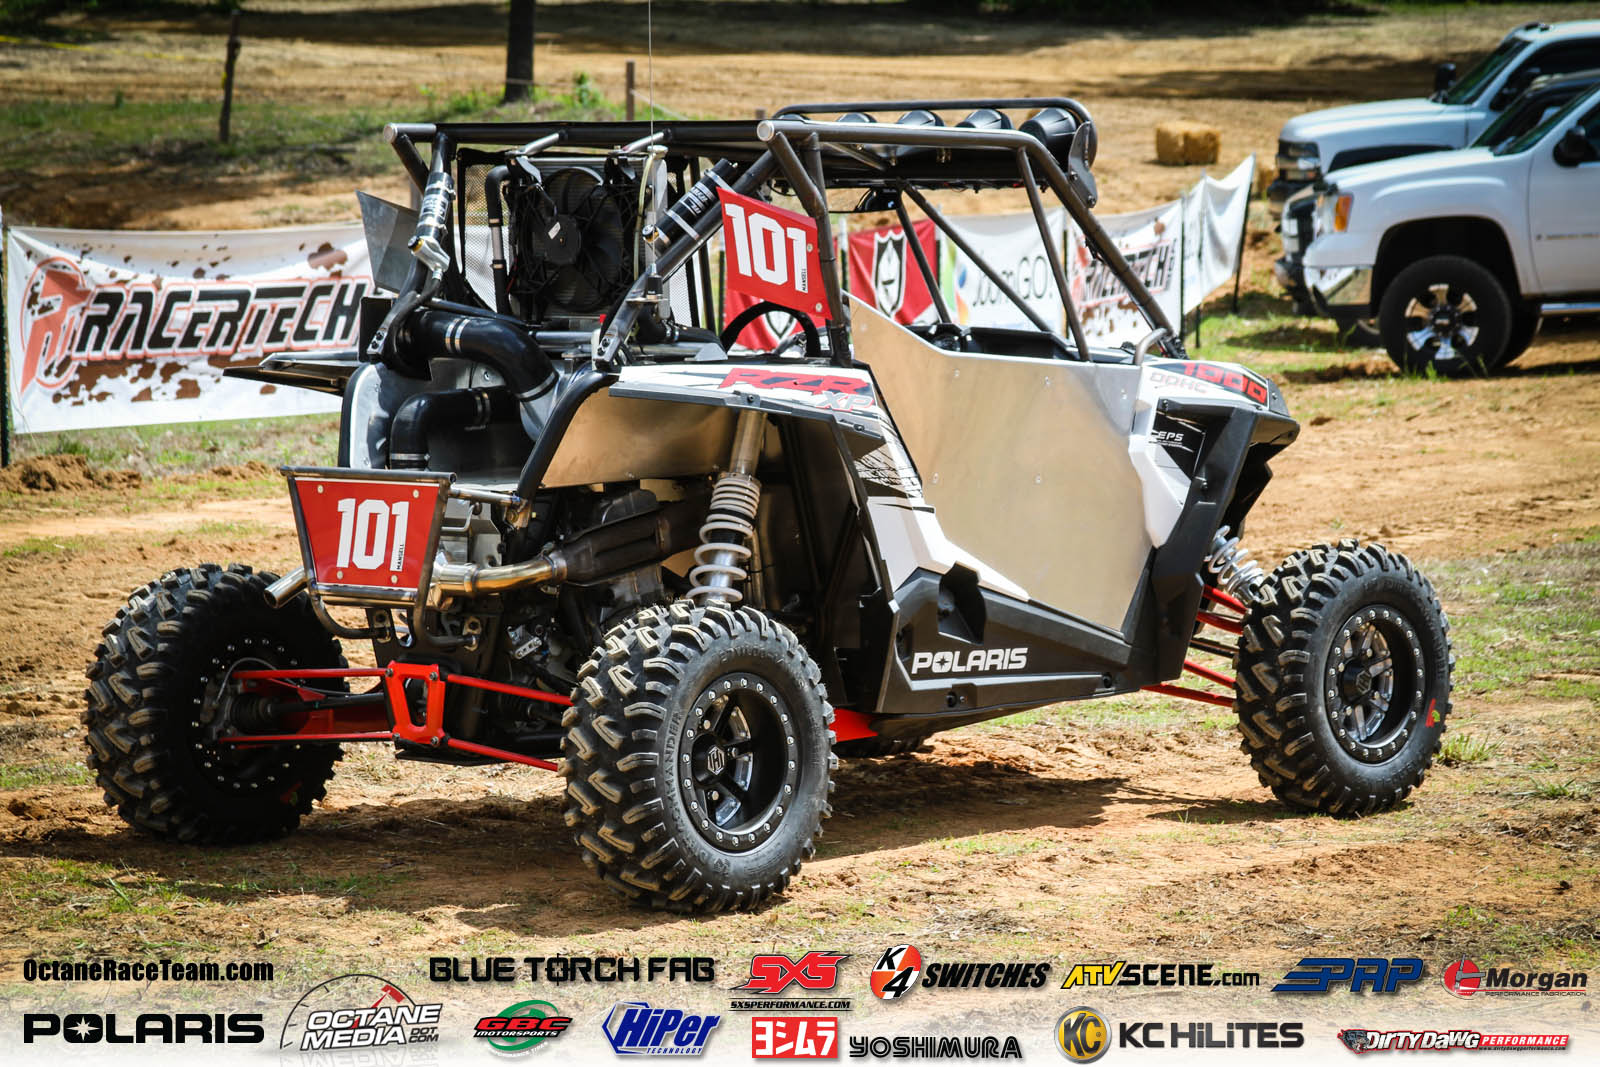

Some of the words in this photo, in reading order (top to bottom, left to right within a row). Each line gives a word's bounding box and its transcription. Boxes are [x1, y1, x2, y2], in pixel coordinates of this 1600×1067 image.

[725, 203, 808, 293] 101
[74, 284, 366, 352] RACERTECH
[717, 368, 872, 395] RZR
[1181, 363, 1267, 404] 1000
[814, 391, 876, 412] XP
[1159, 431, 1184, 442] EPS
[336, 498, 410, 572] 101
[911, 648, 1028, 675] POLARIS
